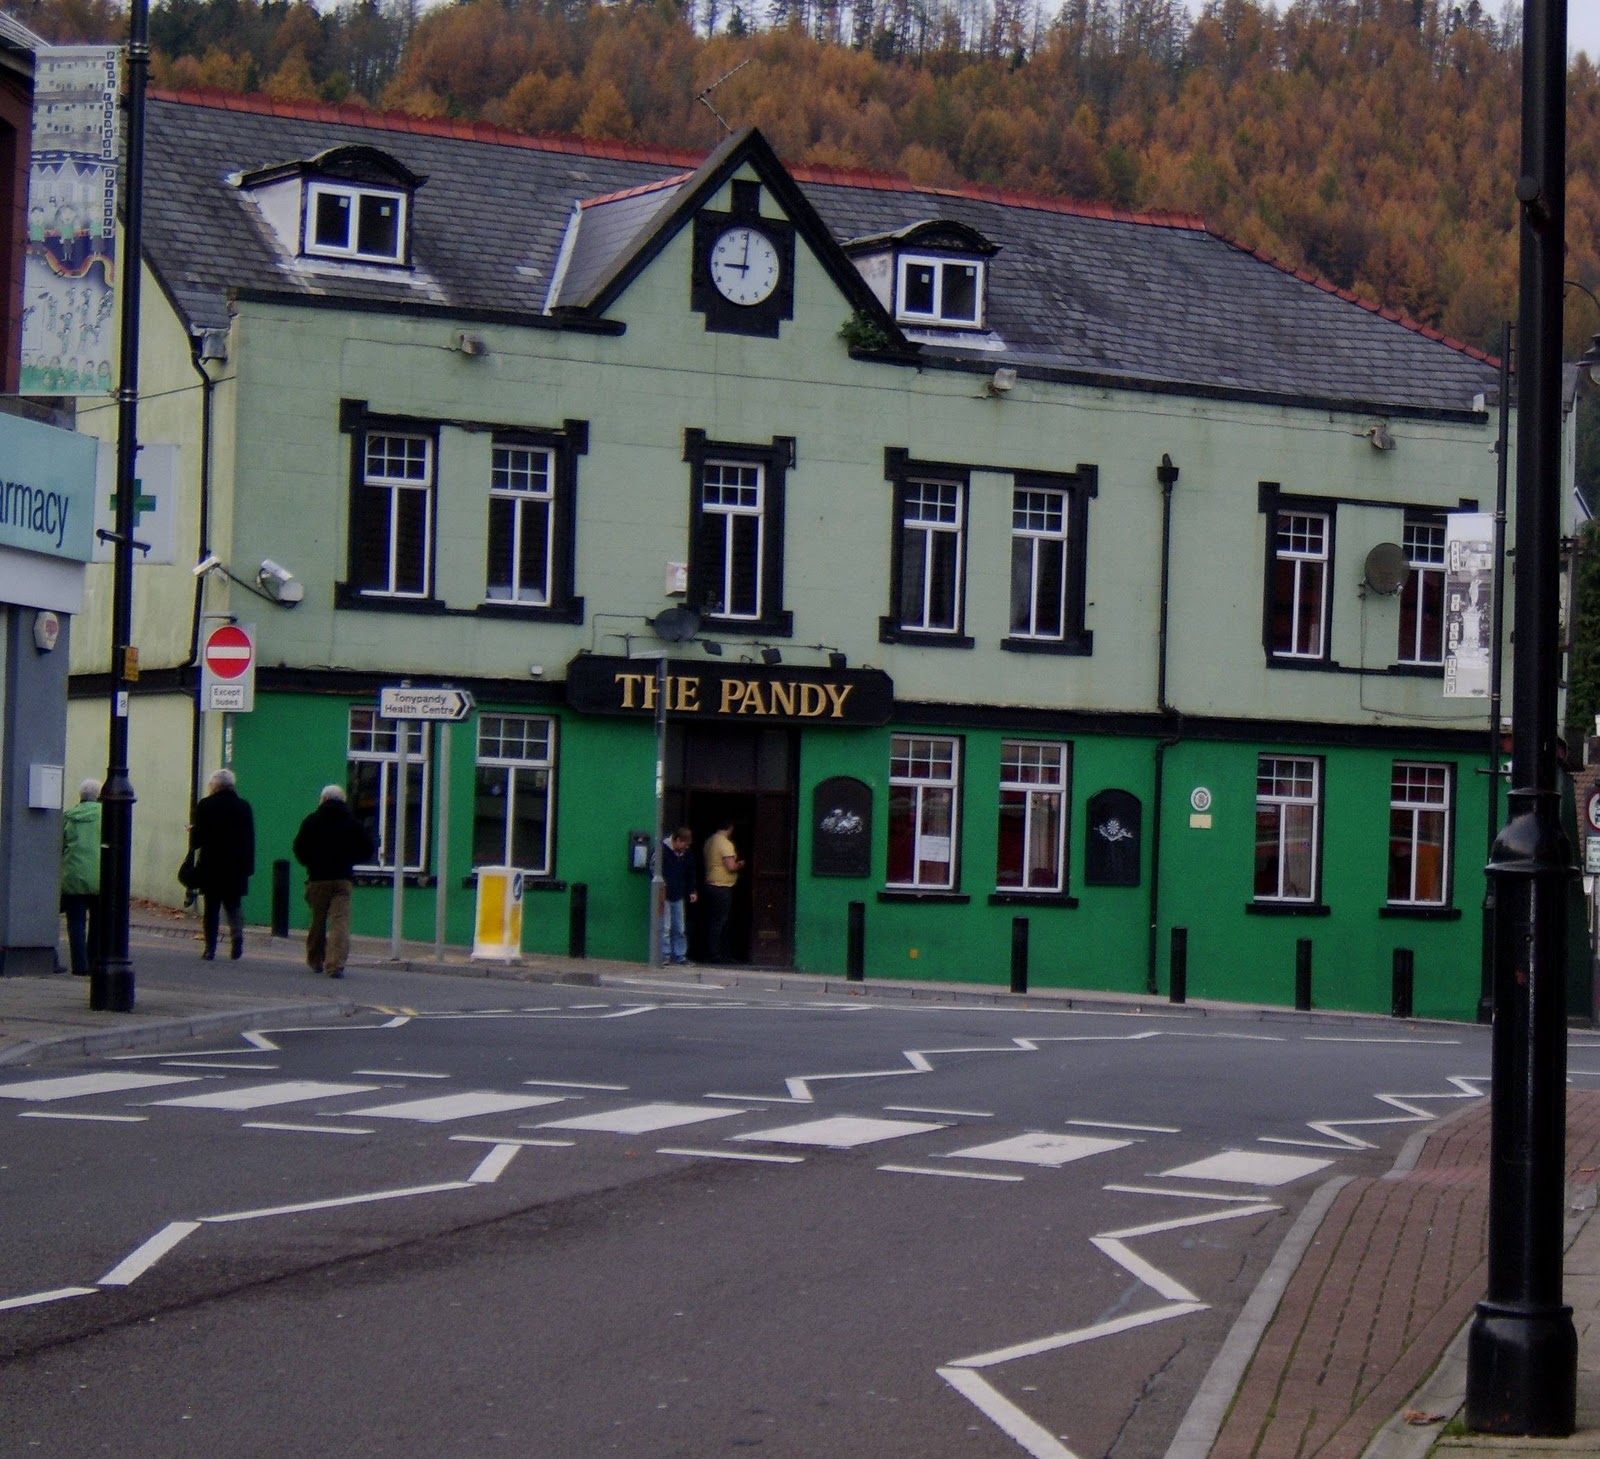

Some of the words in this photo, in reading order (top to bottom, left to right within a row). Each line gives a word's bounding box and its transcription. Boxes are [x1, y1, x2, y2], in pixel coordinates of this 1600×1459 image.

[213, 687, 240, 697] Except
[614, 673, 699, 712] THE
[718, 678, 853, 718] PANDY
[394, 692, 447, 704] Tonypandy
[385, 704, 417, 714] Health
[421, 704, 454, 715] Centre
